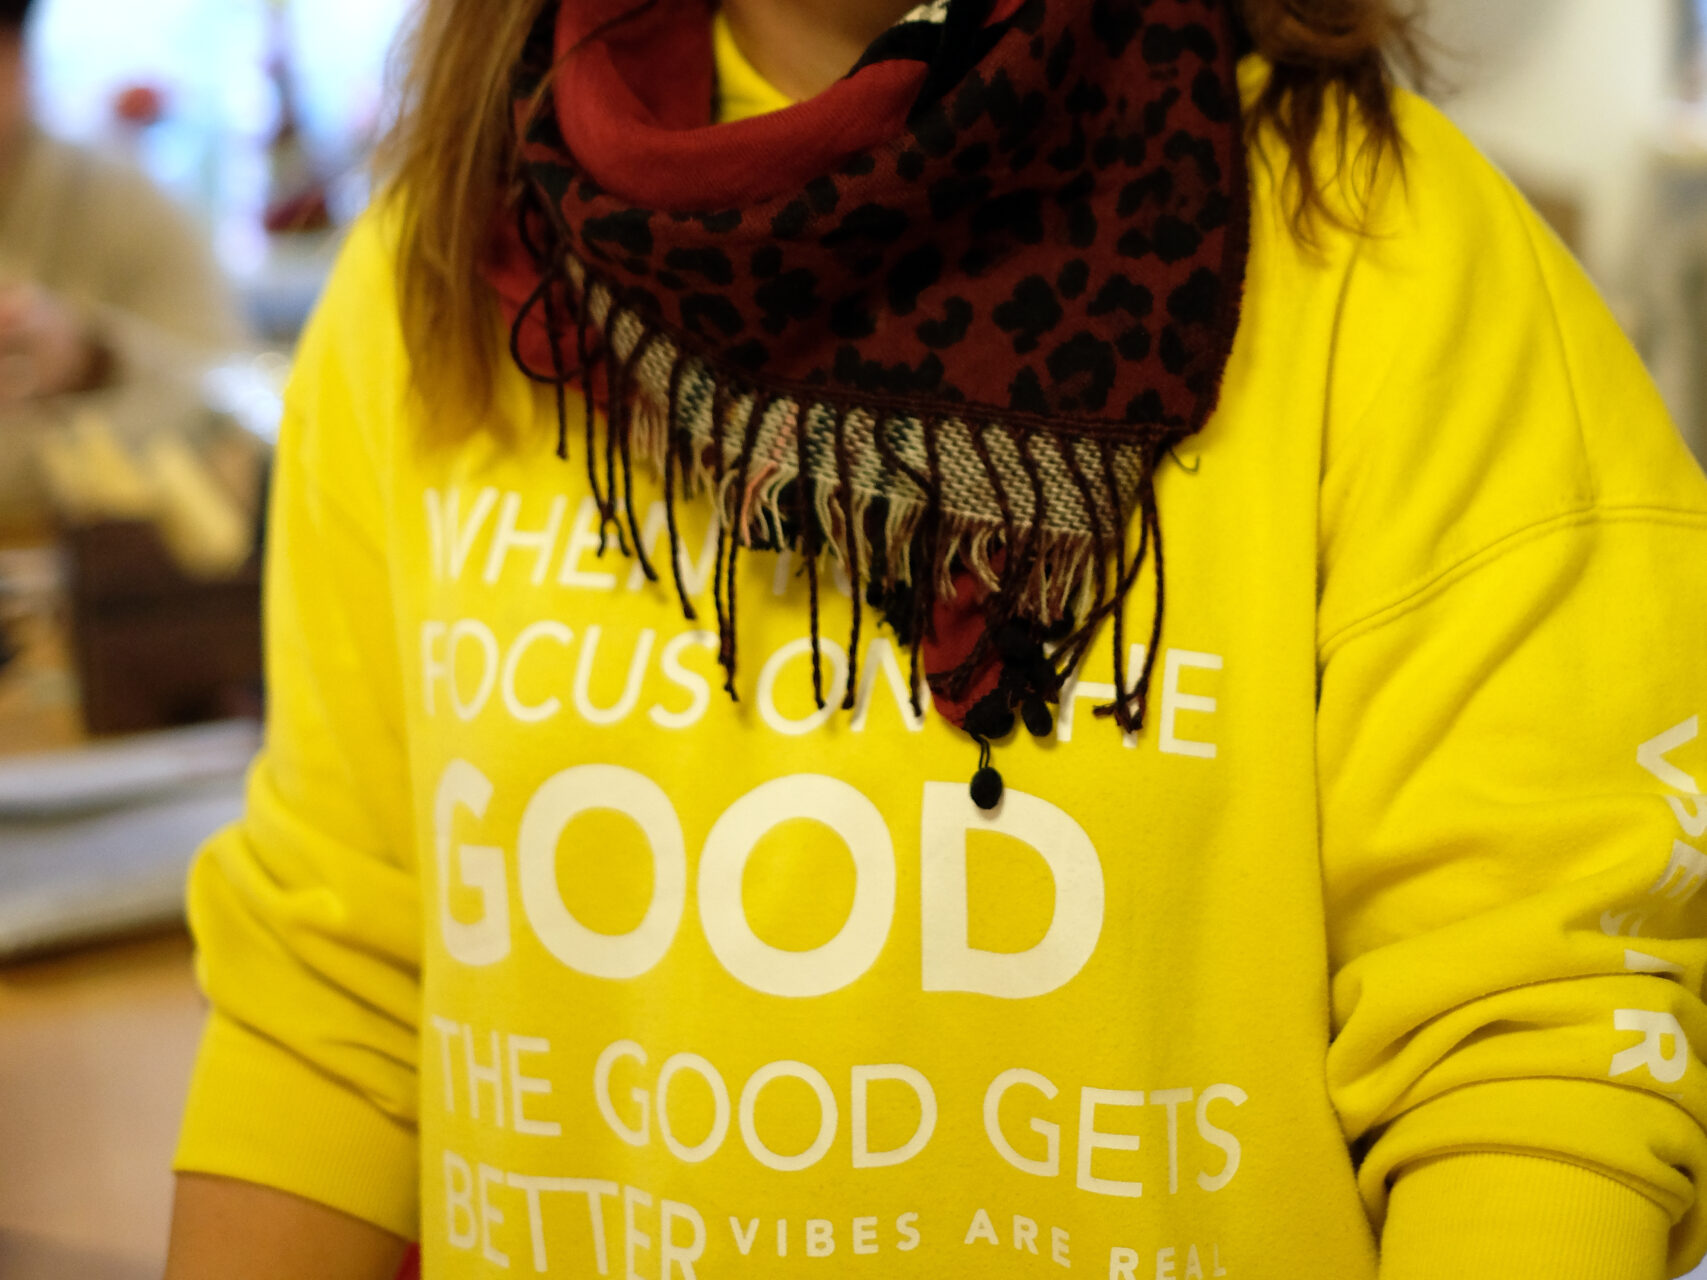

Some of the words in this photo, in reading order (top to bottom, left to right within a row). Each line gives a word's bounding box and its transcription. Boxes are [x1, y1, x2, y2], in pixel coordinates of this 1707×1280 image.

[423, 486, 720, 597] WHEN
[422, 618, 720, 730] FOCUS
[757, 636, 932, 734] ON
[1043, 642, 1223, 758] HE
[434, 757, 1105, 1000] GOOD
[432, 1013, 562, 1137] THE
[594, 1039, 938, 1172] GOOD
[983, 1067, 1249, 1198] GETS
[443, 1149, 707, 1280] BETTER
[729, 1212, 921, 1258] VIBES
[964, 1208, 1071, 1269] ARE
[1109, 1243, 1227, 1280] REAL
